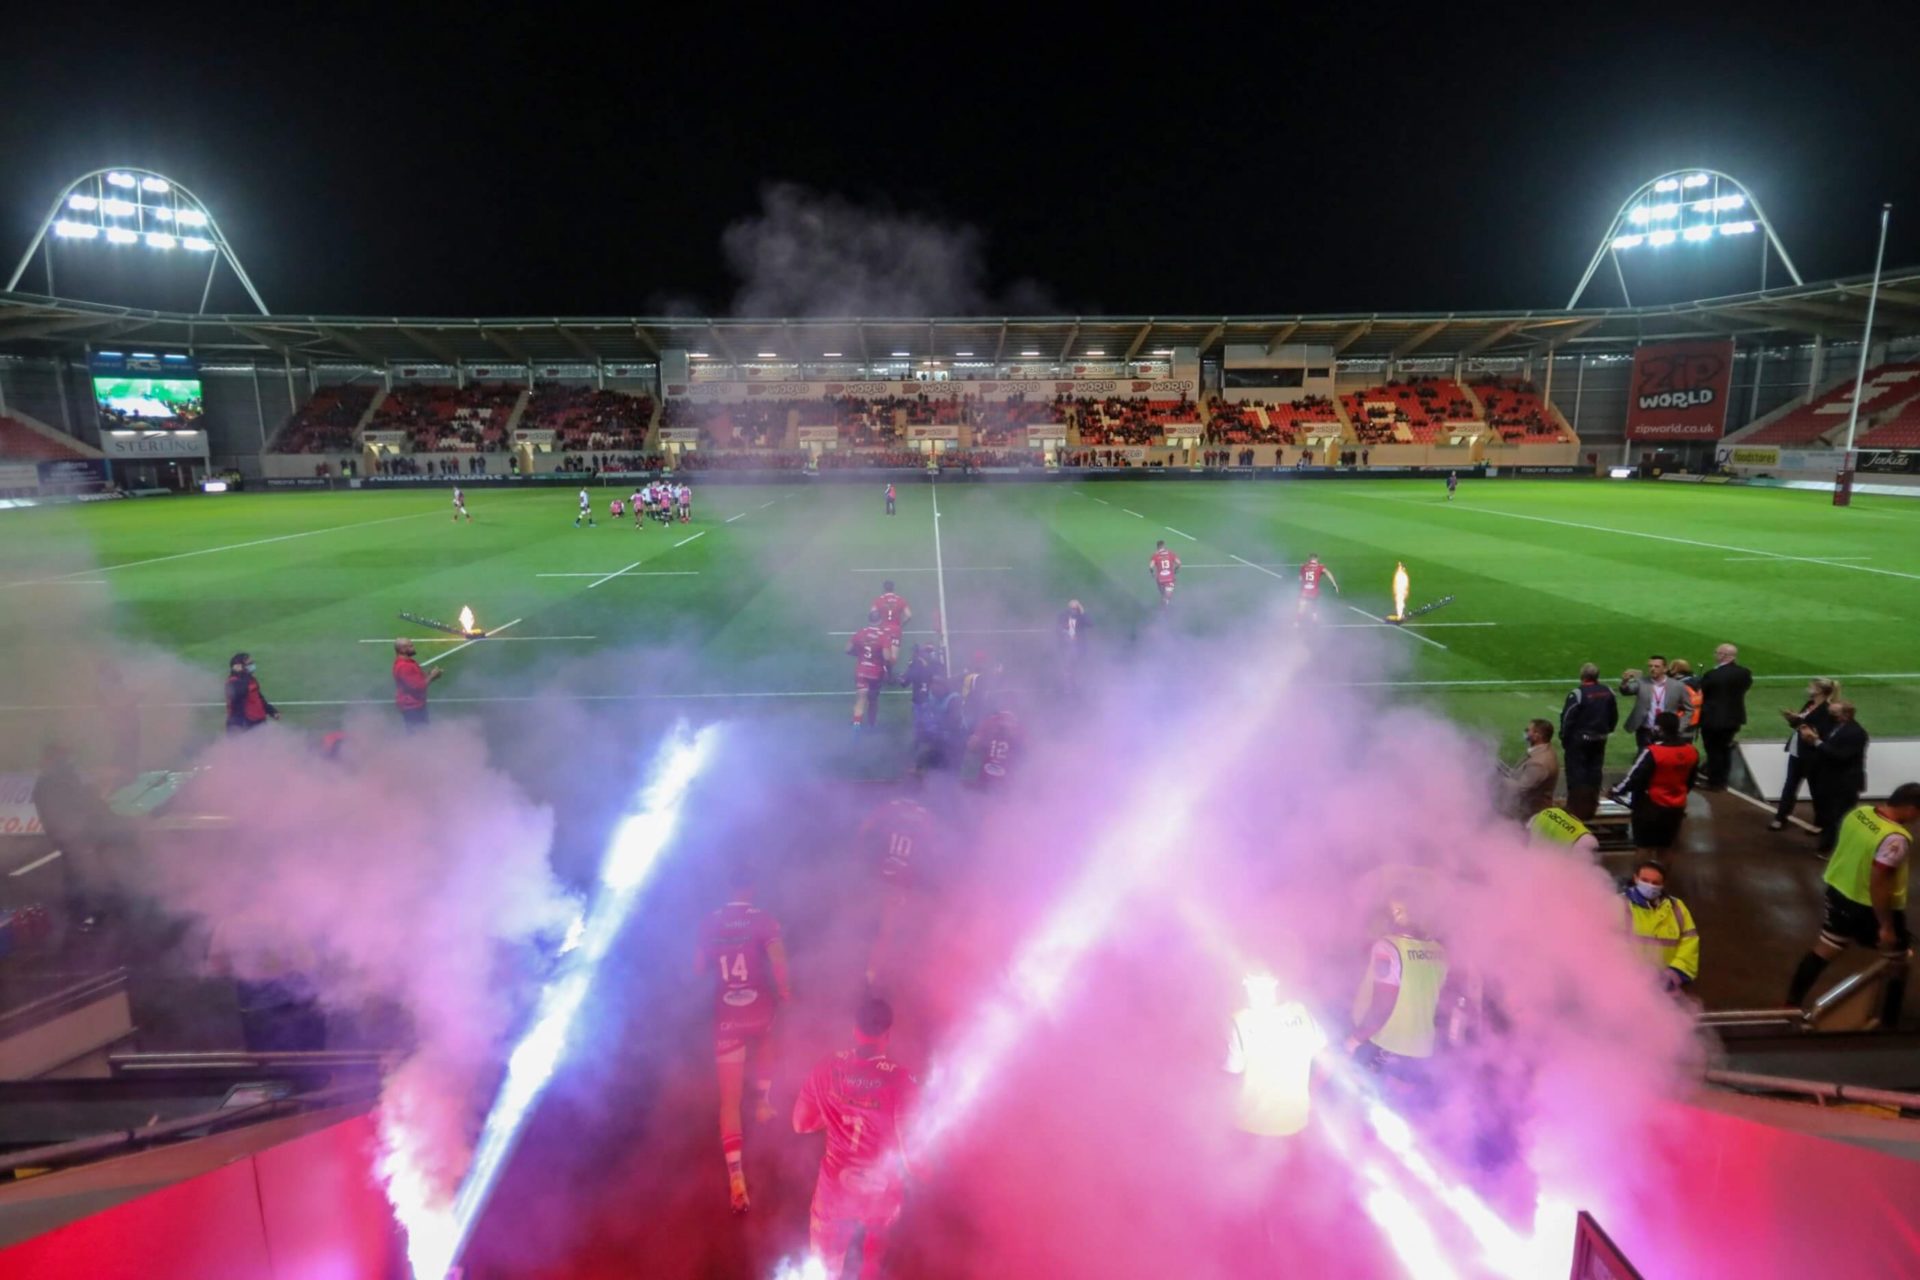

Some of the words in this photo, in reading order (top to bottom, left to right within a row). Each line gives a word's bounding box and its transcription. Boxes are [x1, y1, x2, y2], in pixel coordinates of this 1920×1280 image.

[846, 383, 886, 395] WORLD
[923, 383, 963, 395] WORLD
[1001, 382, 1040, 393] WORLD
[1076, 382, 1116, 393] WORLD
[1153, 380, 1194, 393] WORLD
[1639, 389, 1713, 408] WORLD
[1635, 422, 1714, 434] zipworld.co.uk
[115, 441, 198, 453] STERLING
[1161, 560, 1170, 569] 13
[1305, 571, 1314, 581] 15
[864, 646, 872, 658] 3
[990, 739, 1009, 759] 12
[1542, 809, 1577, 834] macron
[888, 833, 912, 857] 10
[719, 952, 748, 982] 14
[842, 1114, 864, 1153] 7
